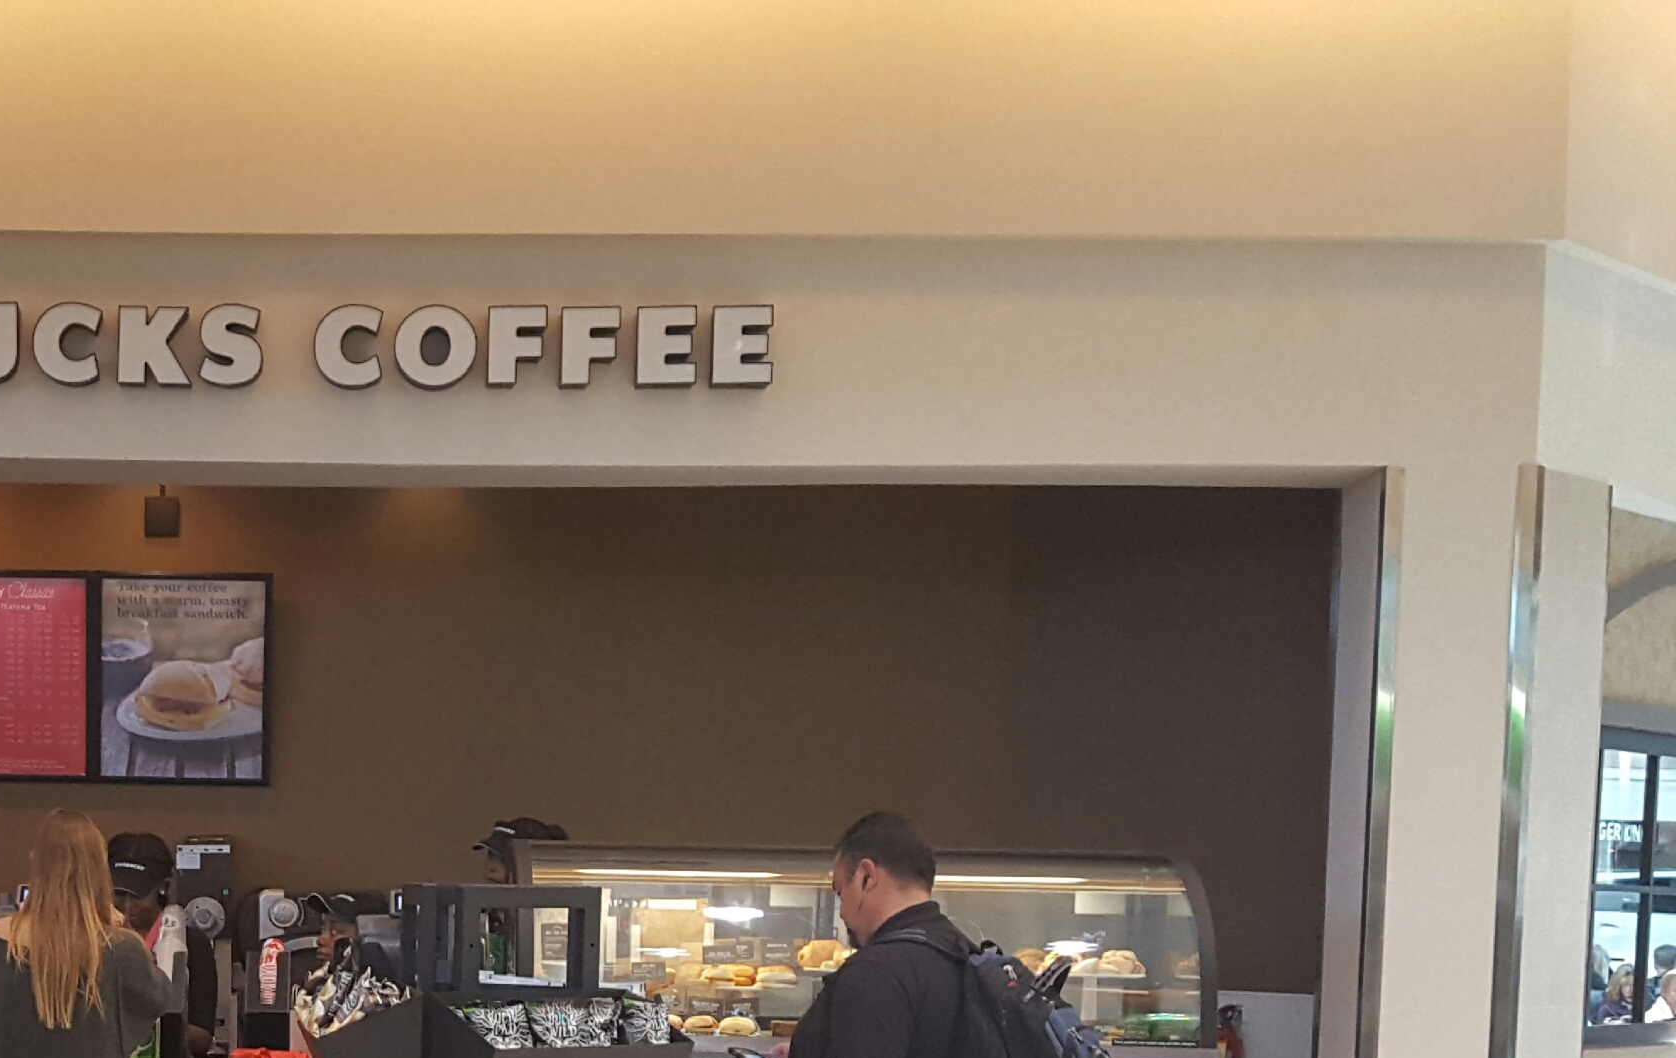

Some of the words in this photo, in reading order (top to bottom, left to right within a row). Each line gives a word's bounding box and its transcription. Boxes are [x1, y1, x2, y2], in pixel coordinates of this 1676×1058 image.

[312, 303, 774, 391] COFFEE
[117, 580, 150, 592] Take
[153, 583, 183, 593] your
[187, 581, 228, 592] coffee
[117, 594, 148, 605] with
[116, 607, 178, 618] breakfast
[183, 608, 249, 620] sandwich.
